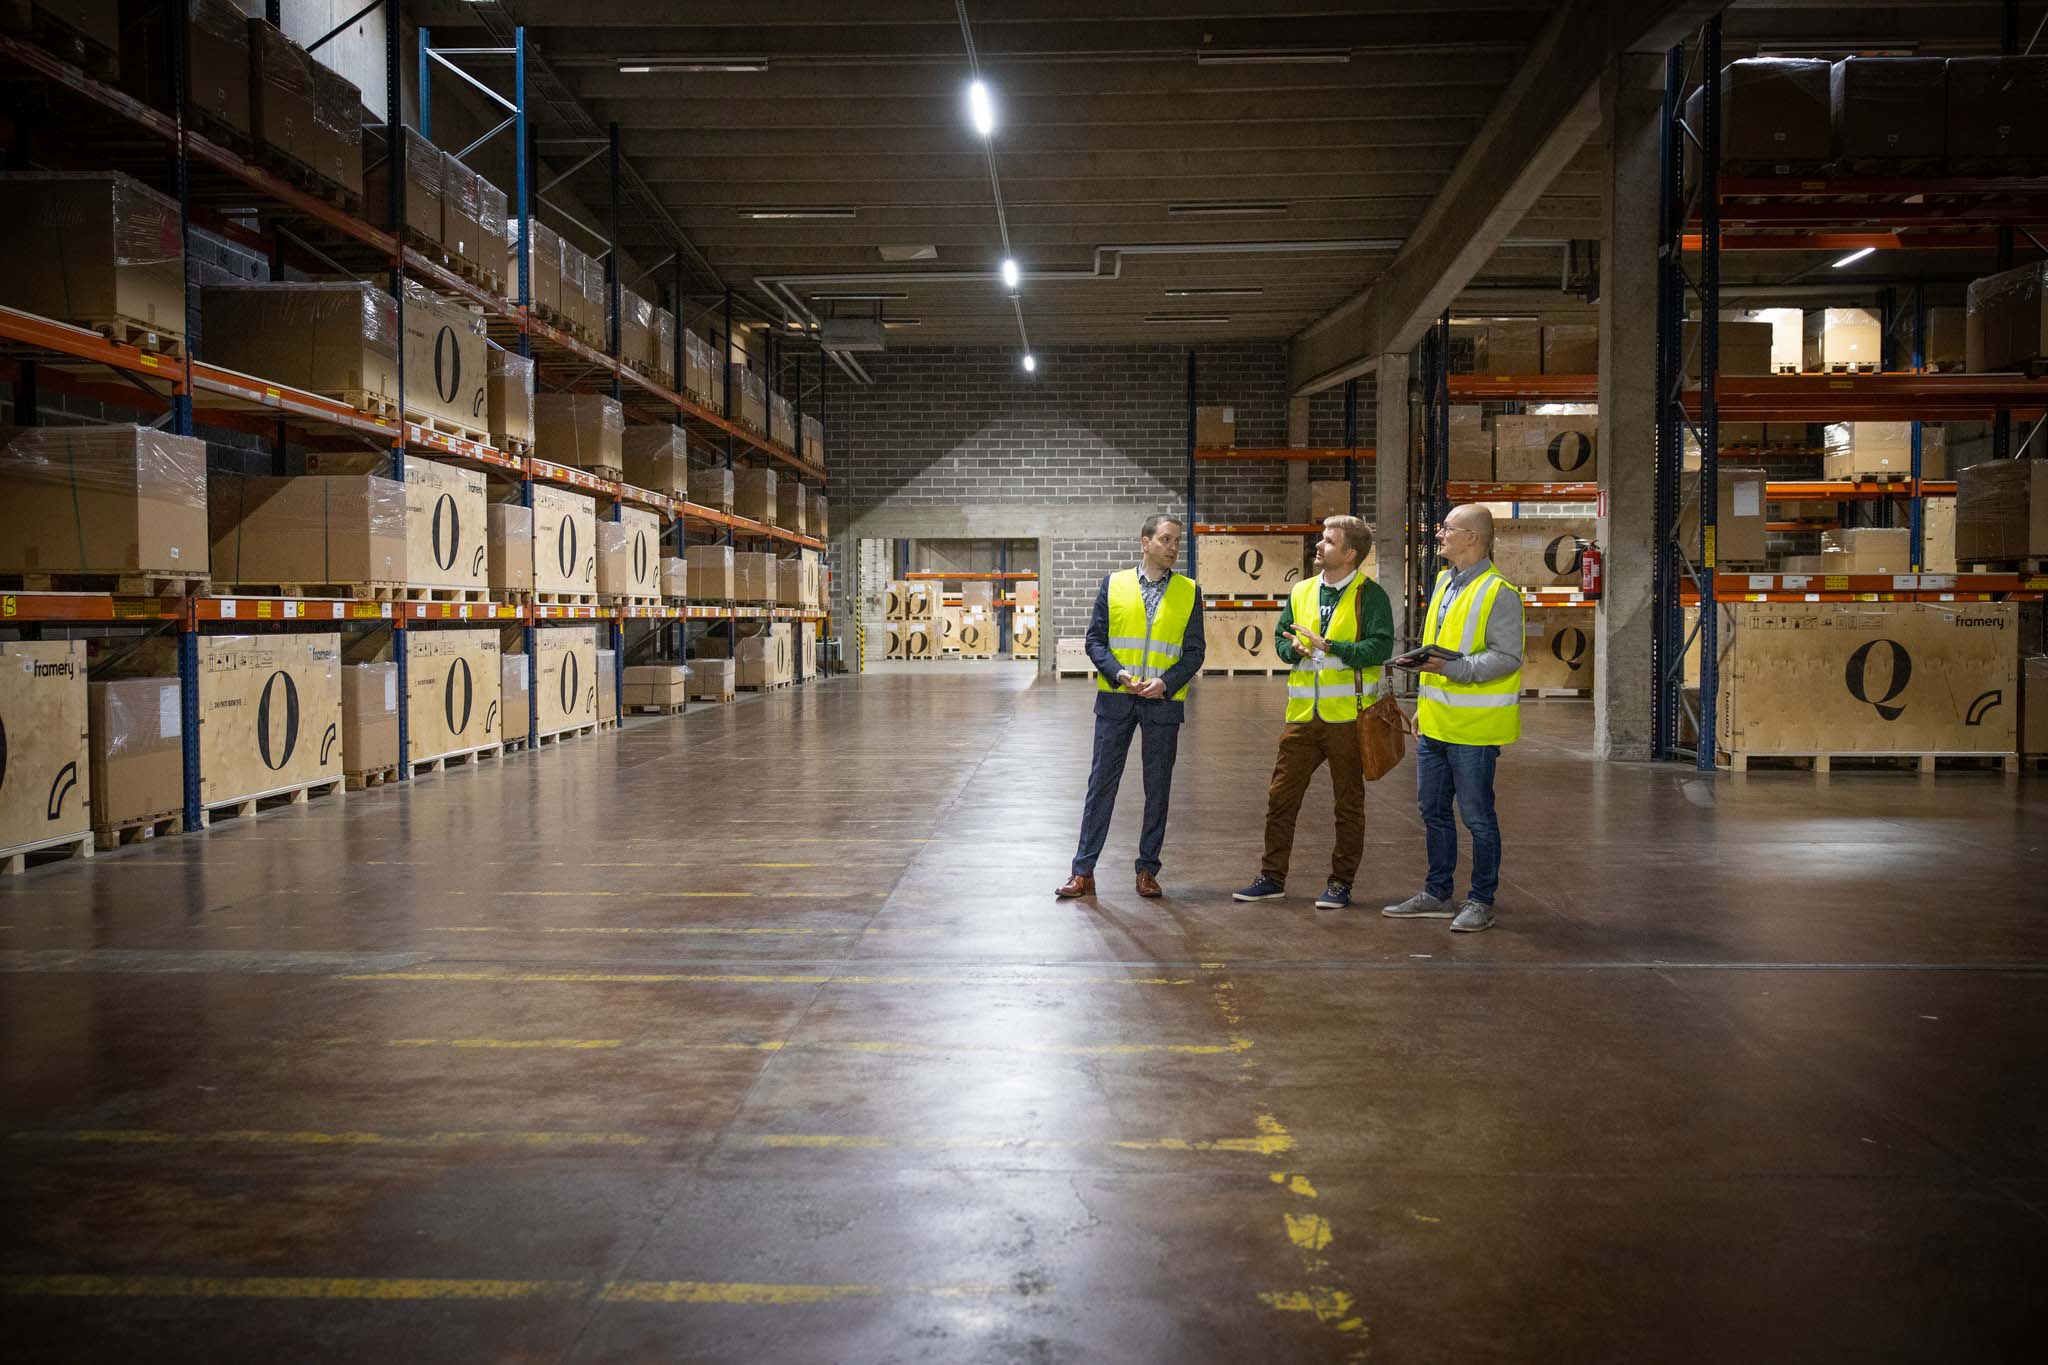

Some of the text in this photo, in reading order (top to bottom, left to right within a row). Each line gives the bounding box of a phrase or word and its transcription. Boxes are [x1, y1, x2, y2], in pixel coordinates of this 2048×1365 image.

[1238, 549, 1264, 581] Q
[960, 625, 979, 648] Q
[1954, 614, 2006, 631] framery
[1237, 625, 1263, 657] Q
[1551, 627, 1587, 671] Q
[34, 659, 74, 681] framery
[1845, 638, 1913, 721] Q
